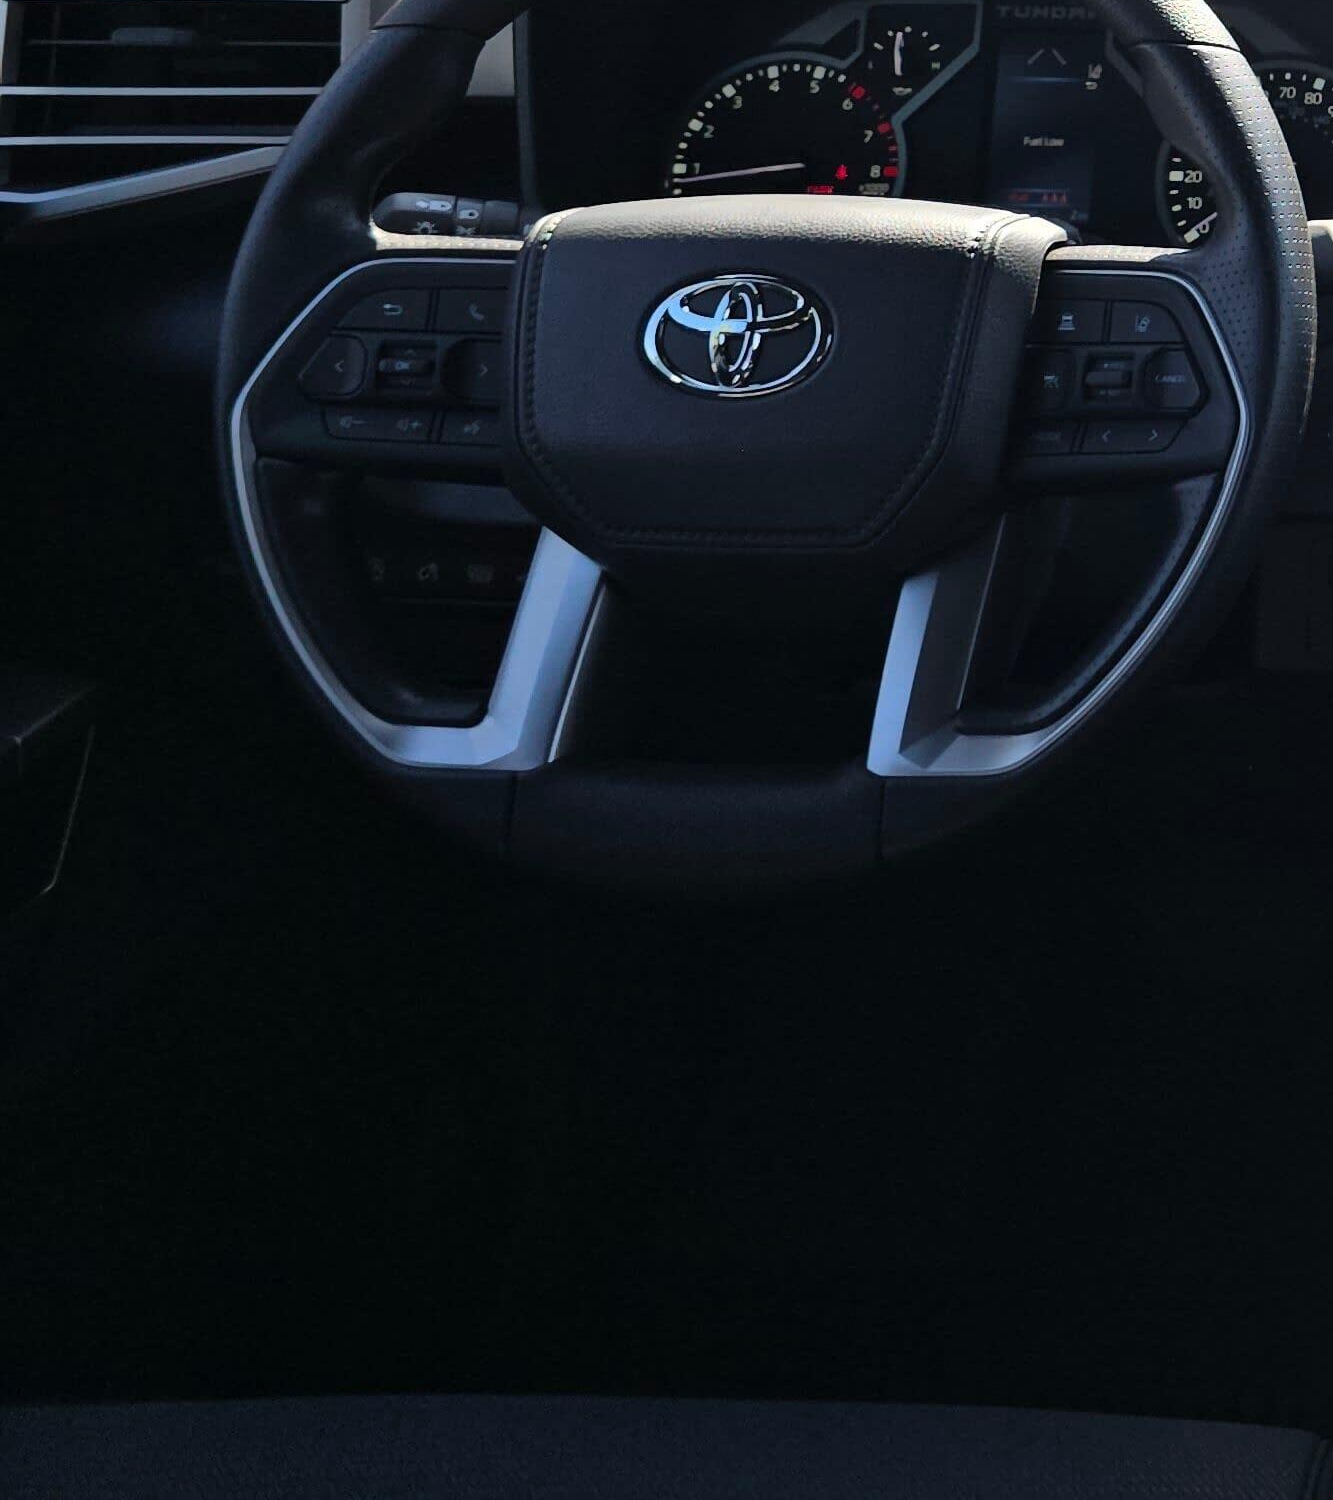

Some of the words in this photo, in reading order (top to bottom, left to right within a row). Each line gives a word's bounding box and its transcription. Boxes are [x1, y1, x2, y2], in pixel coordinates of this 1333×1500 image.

[768, 79, 780, 93] 4
[809, 79, 821, 94] 5
[1279, 86, 1297, 100] 70
[732, 96, 744, 110] 3
[841, 97, 854, 111] 6
[1304, 92, 1323, 105] 80
[702, 124, 715, 139] 2
[863, 128, 874, 144] 7
[870, 164, 881, 178] 8
[1184, 169, 1203, 184] 20
[1187, 196, 1203, 210] 10
